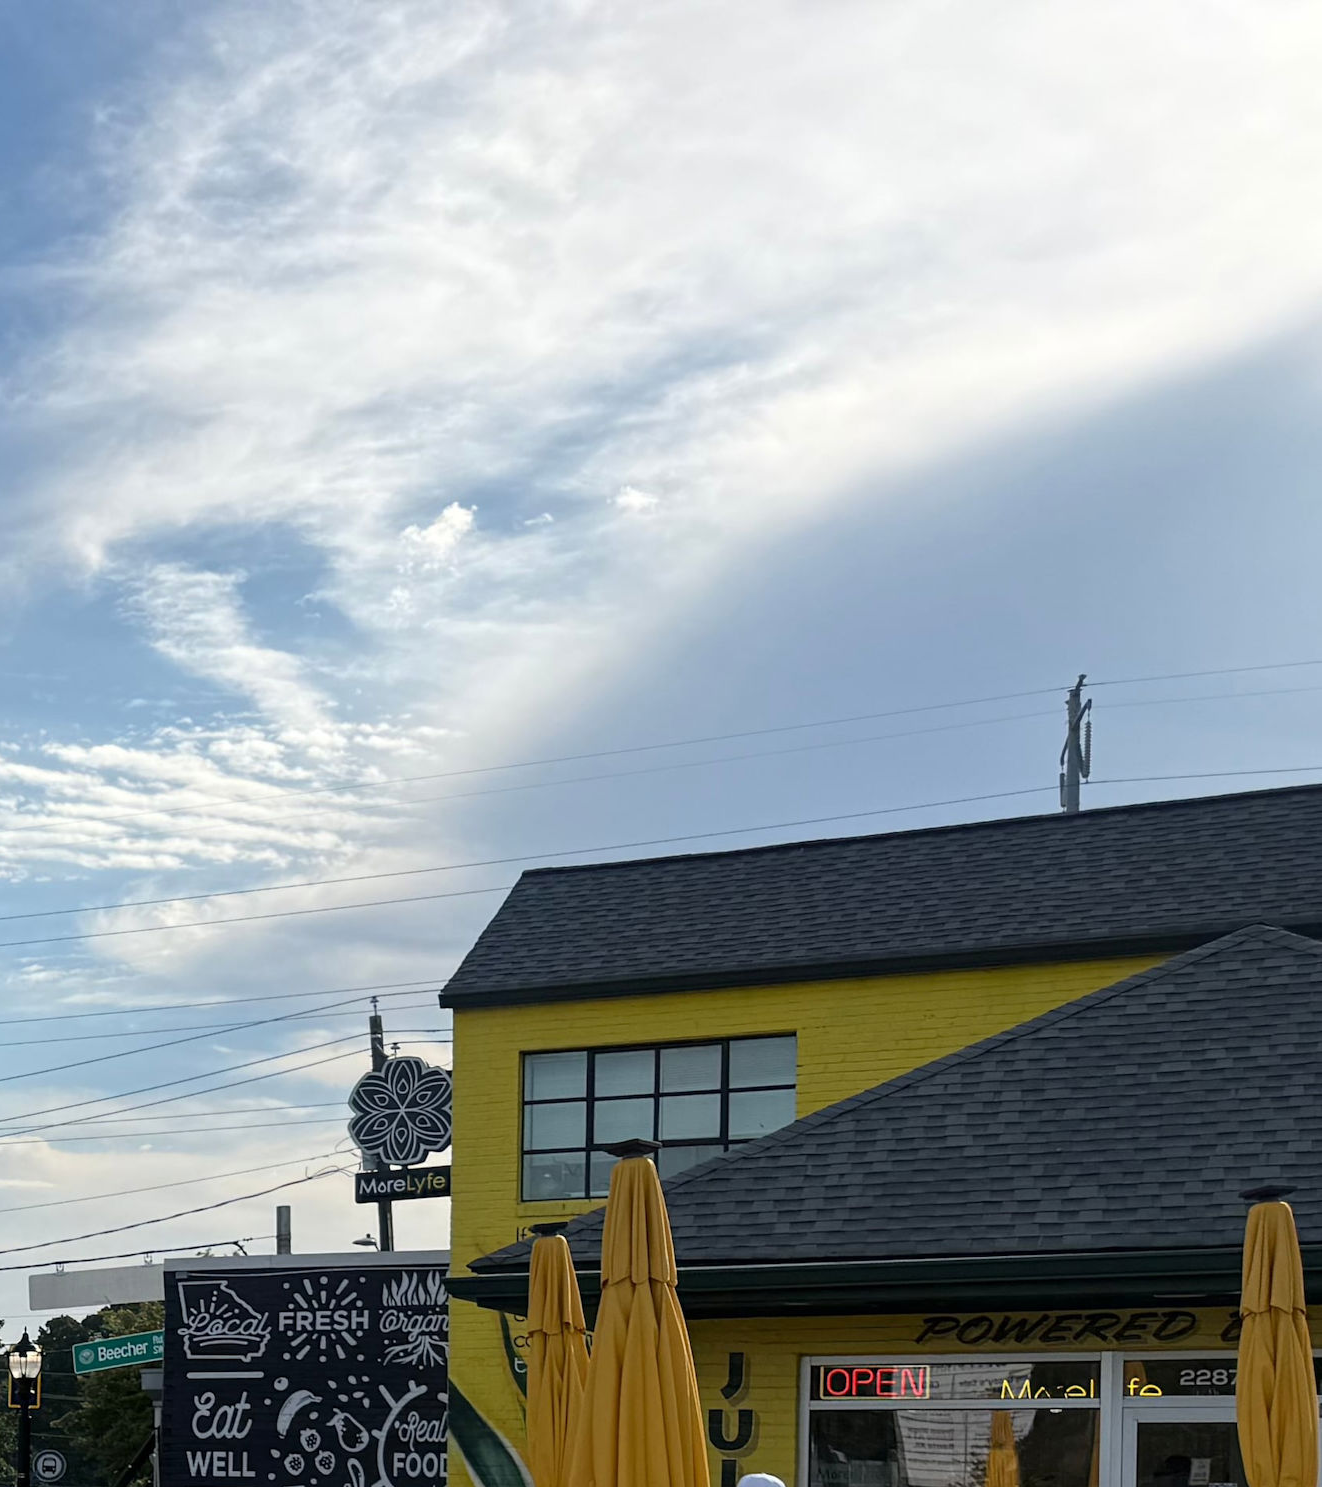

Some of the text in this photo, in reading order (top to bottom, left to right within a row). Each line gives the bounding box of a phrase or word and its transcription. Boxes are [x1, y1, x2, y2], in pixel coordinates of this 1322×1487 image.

[359, 1173, 446, 1195] MoreLyfe
[178, 1312, 272, 1336] Local
[278, 1311, 370, 1332] FRESH
[914, 1311, 1198, 1344] POWERED
[97, 1342, 148, 1362] Beecher
[826, 1368, 925, 1397] OPEN
[1180, 1369, 1238, 1386] 2287
[192, 1391, 253, 1439] Eat
[398, 1411, 448, 1451] Real
[185, 1451, 256, 1478] WELL
